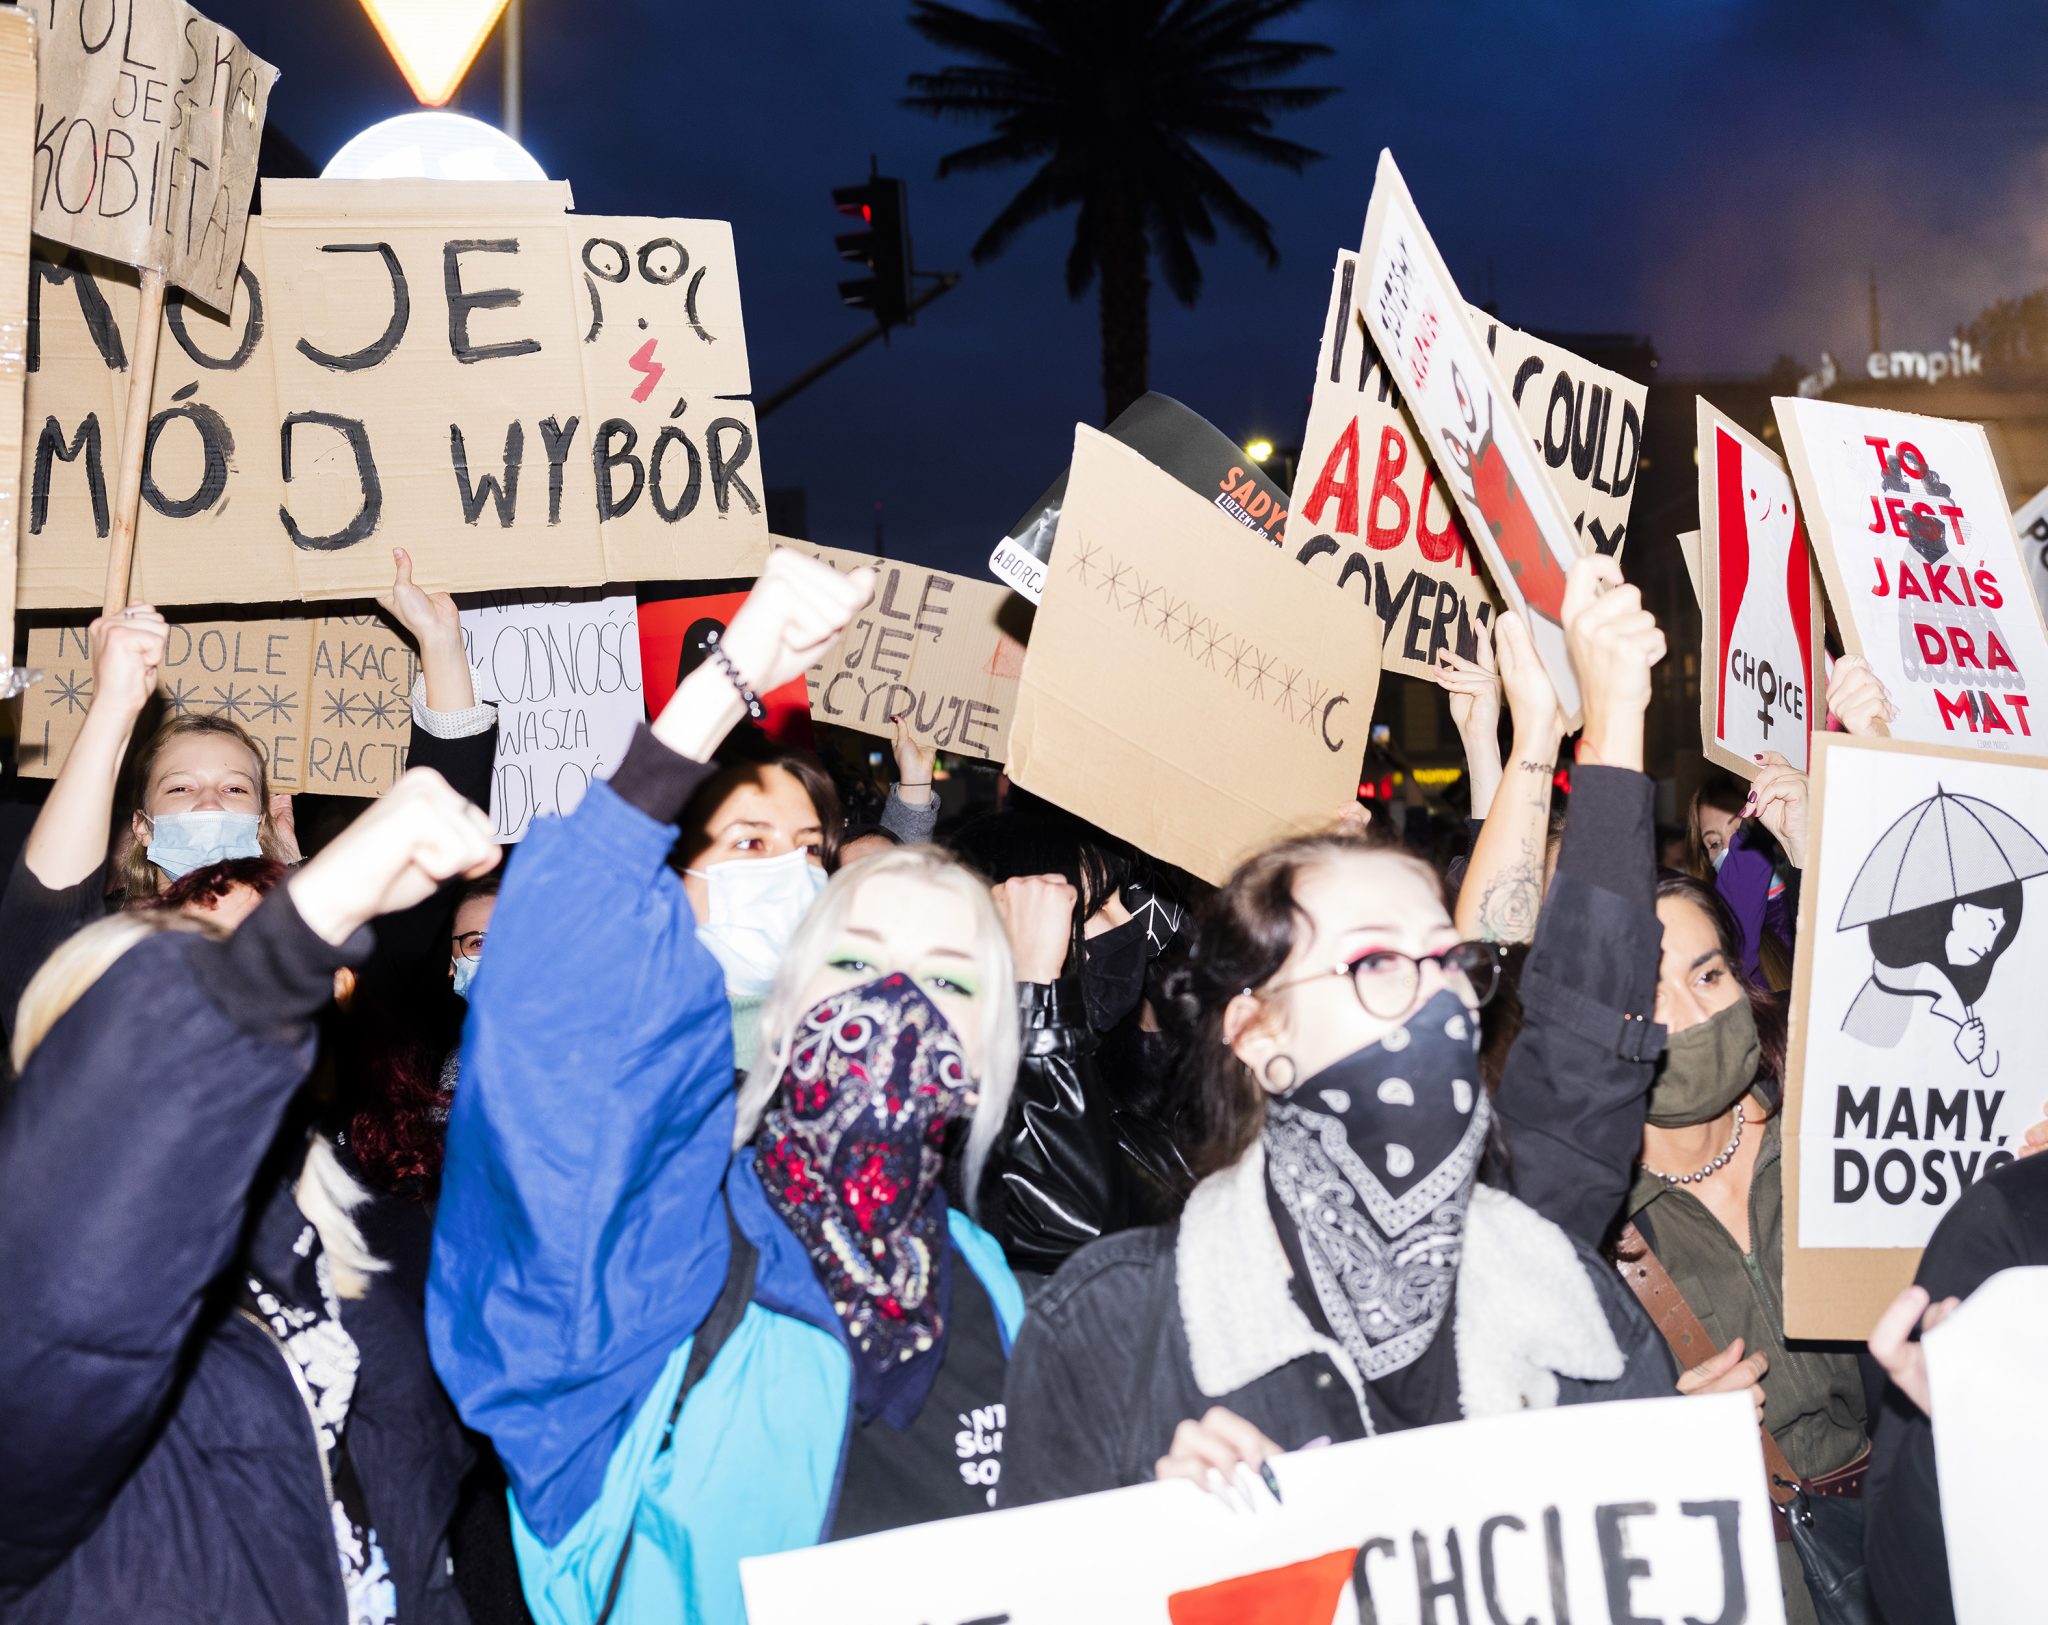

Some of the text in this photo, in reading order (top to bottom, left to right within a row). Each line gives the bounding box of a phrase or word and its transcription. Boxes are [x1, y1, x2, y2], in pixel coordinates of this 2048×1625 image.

[112, 70, 199, 140] JEST
[26, 238, 541, 373] MOJE
[1867, 337, 1982, 386] empik
[1512, 355, 1641, 498] COULD
[30, 381, 761, 552] MÓJ WYBÓR
[1864, 434, 1928, 481] TO
[1302, 415, 1483, 576] ABO
[1868, 494, 1968, 546] JEST
[1871, 557, 2004, 610] JAKIŚ
[164, 623, 290, 676] DOLE
[1914, 622, 2019, 673] DRA
[1731, 648, 1803, 740] CHOICE
[1933, 688, 2033, 738] MAT
[497, 707, 589, 757] WASZA
[1833, 1084, 2009, 1147] MAMY,
[1352, 1499, 1749, 1625] CHCIEJ
